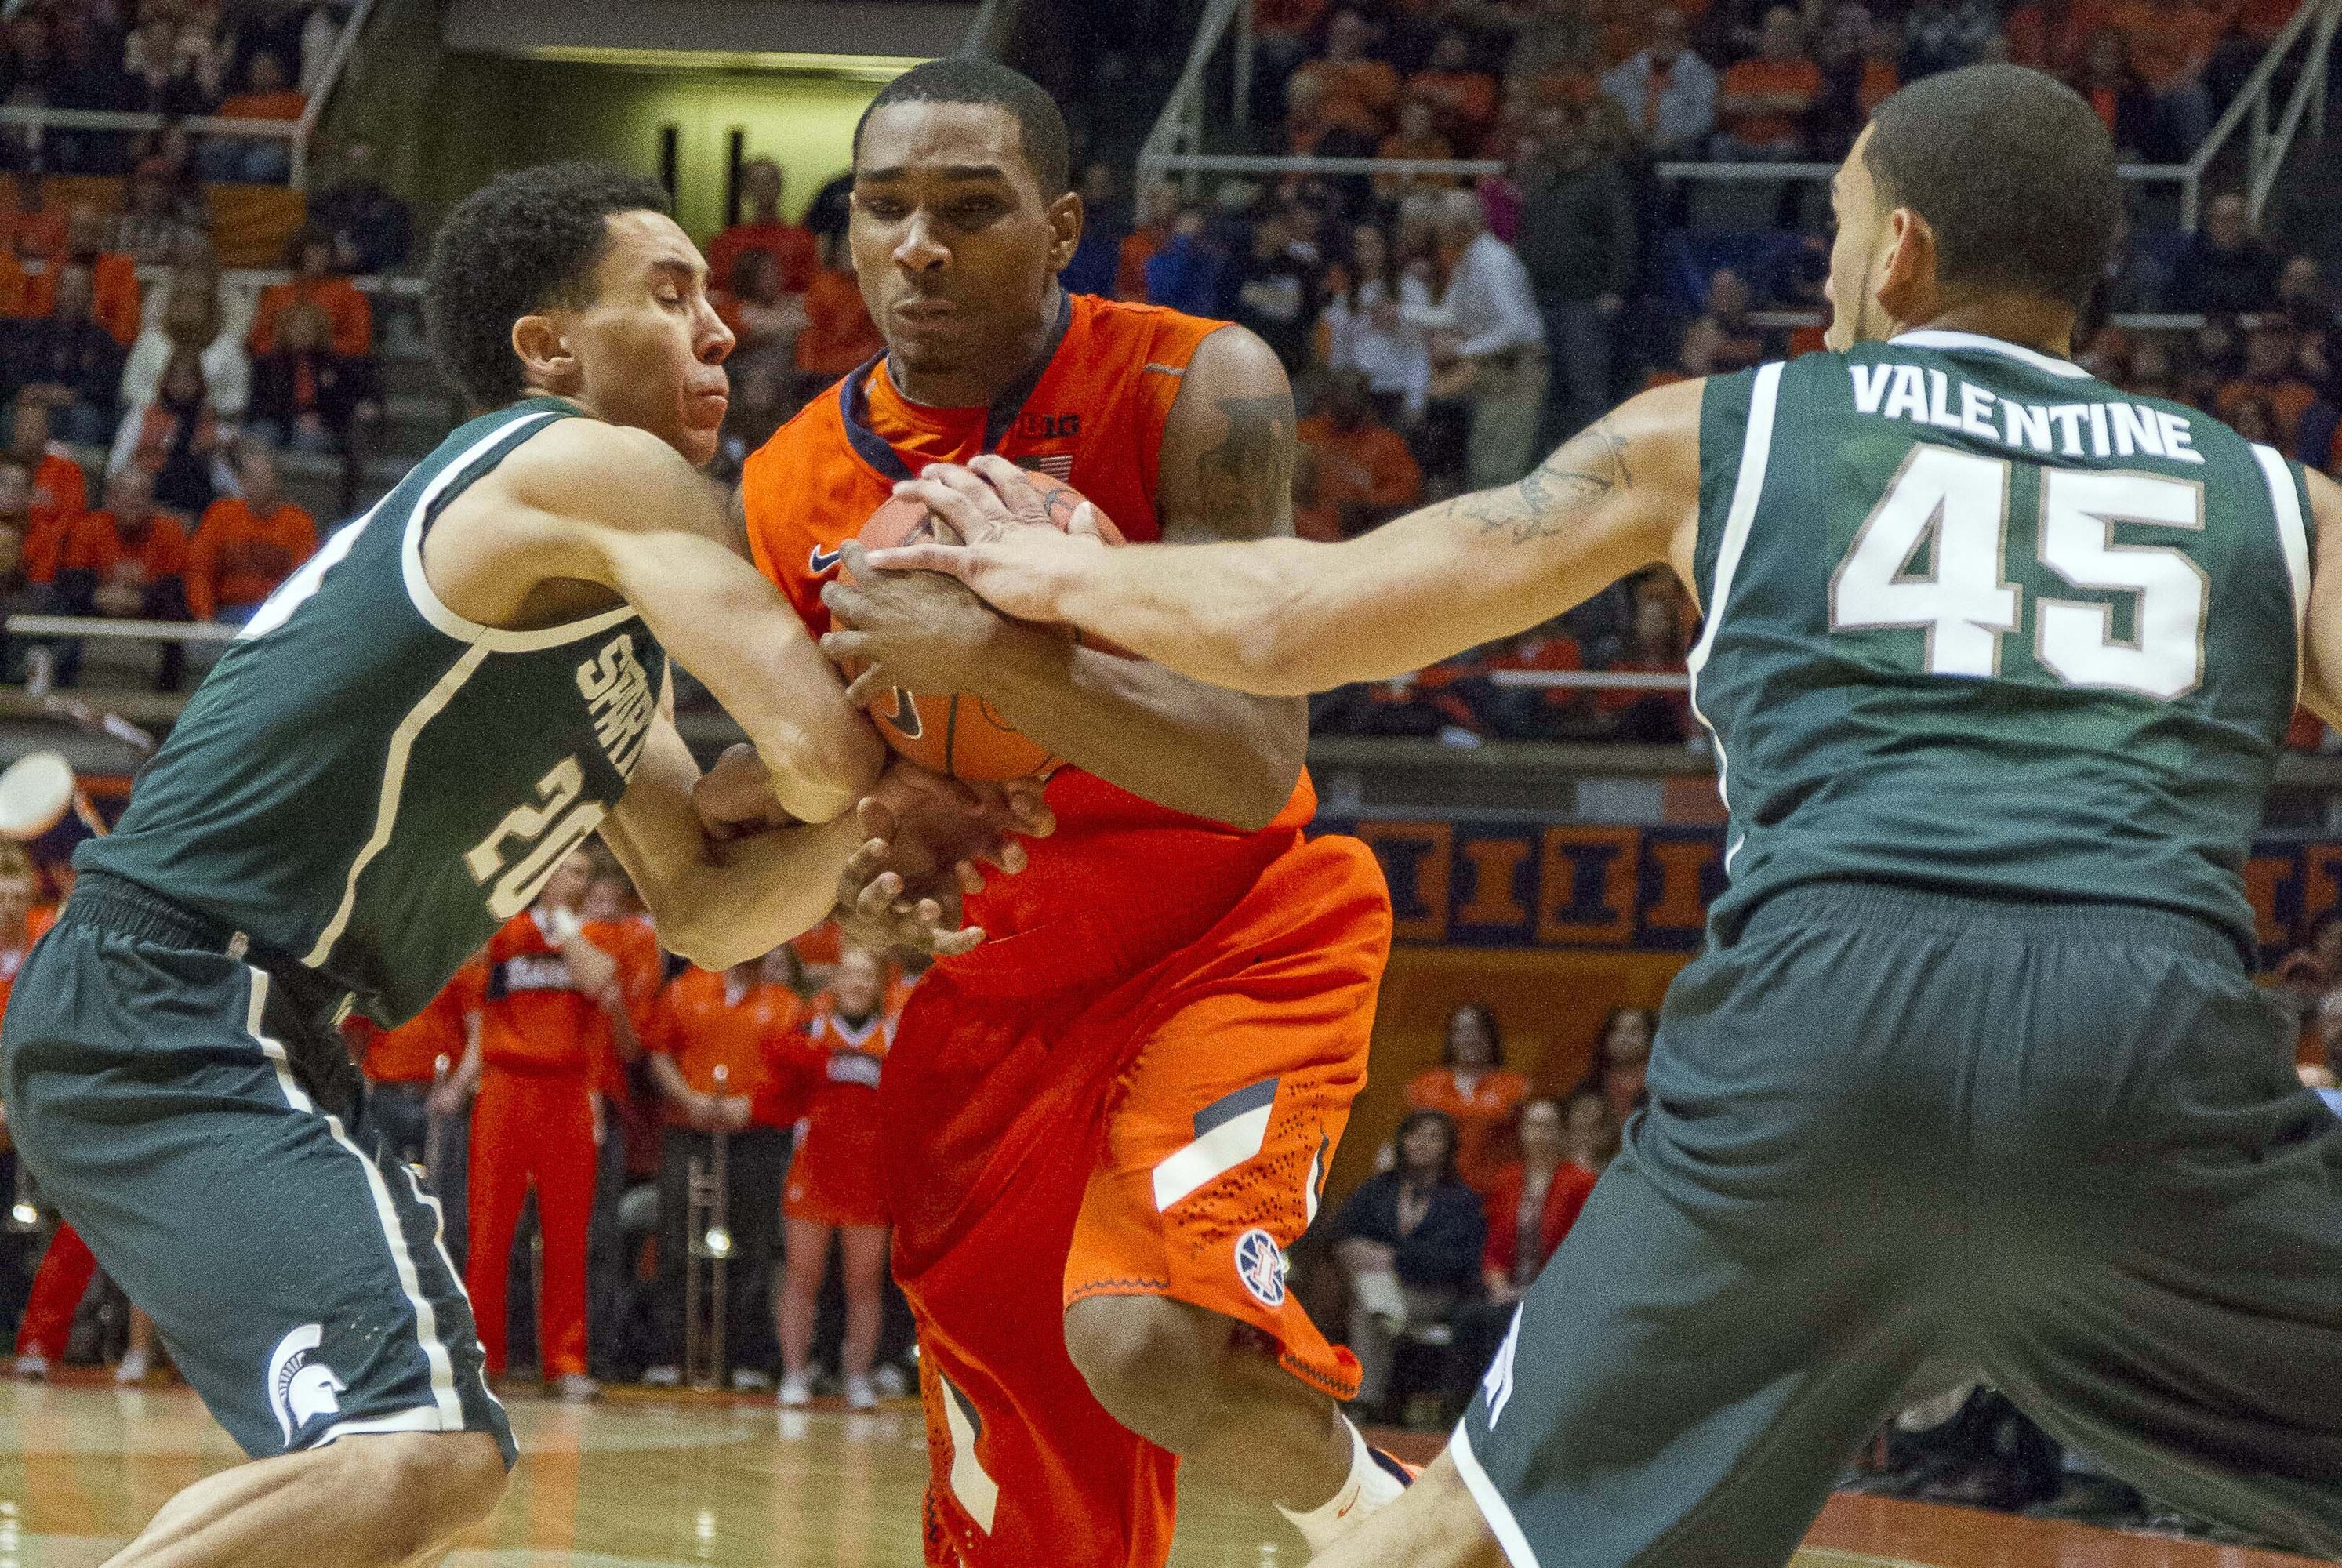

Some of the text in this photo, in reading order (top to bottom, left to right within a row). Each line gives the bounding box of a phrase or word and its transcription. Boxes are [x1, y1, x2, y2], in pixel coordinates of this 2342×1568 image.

[1849, 364, 2205, 463] VALENTINE
[1829, 444, 2209, 700] 45
[464, 754, 606, 919] 20
